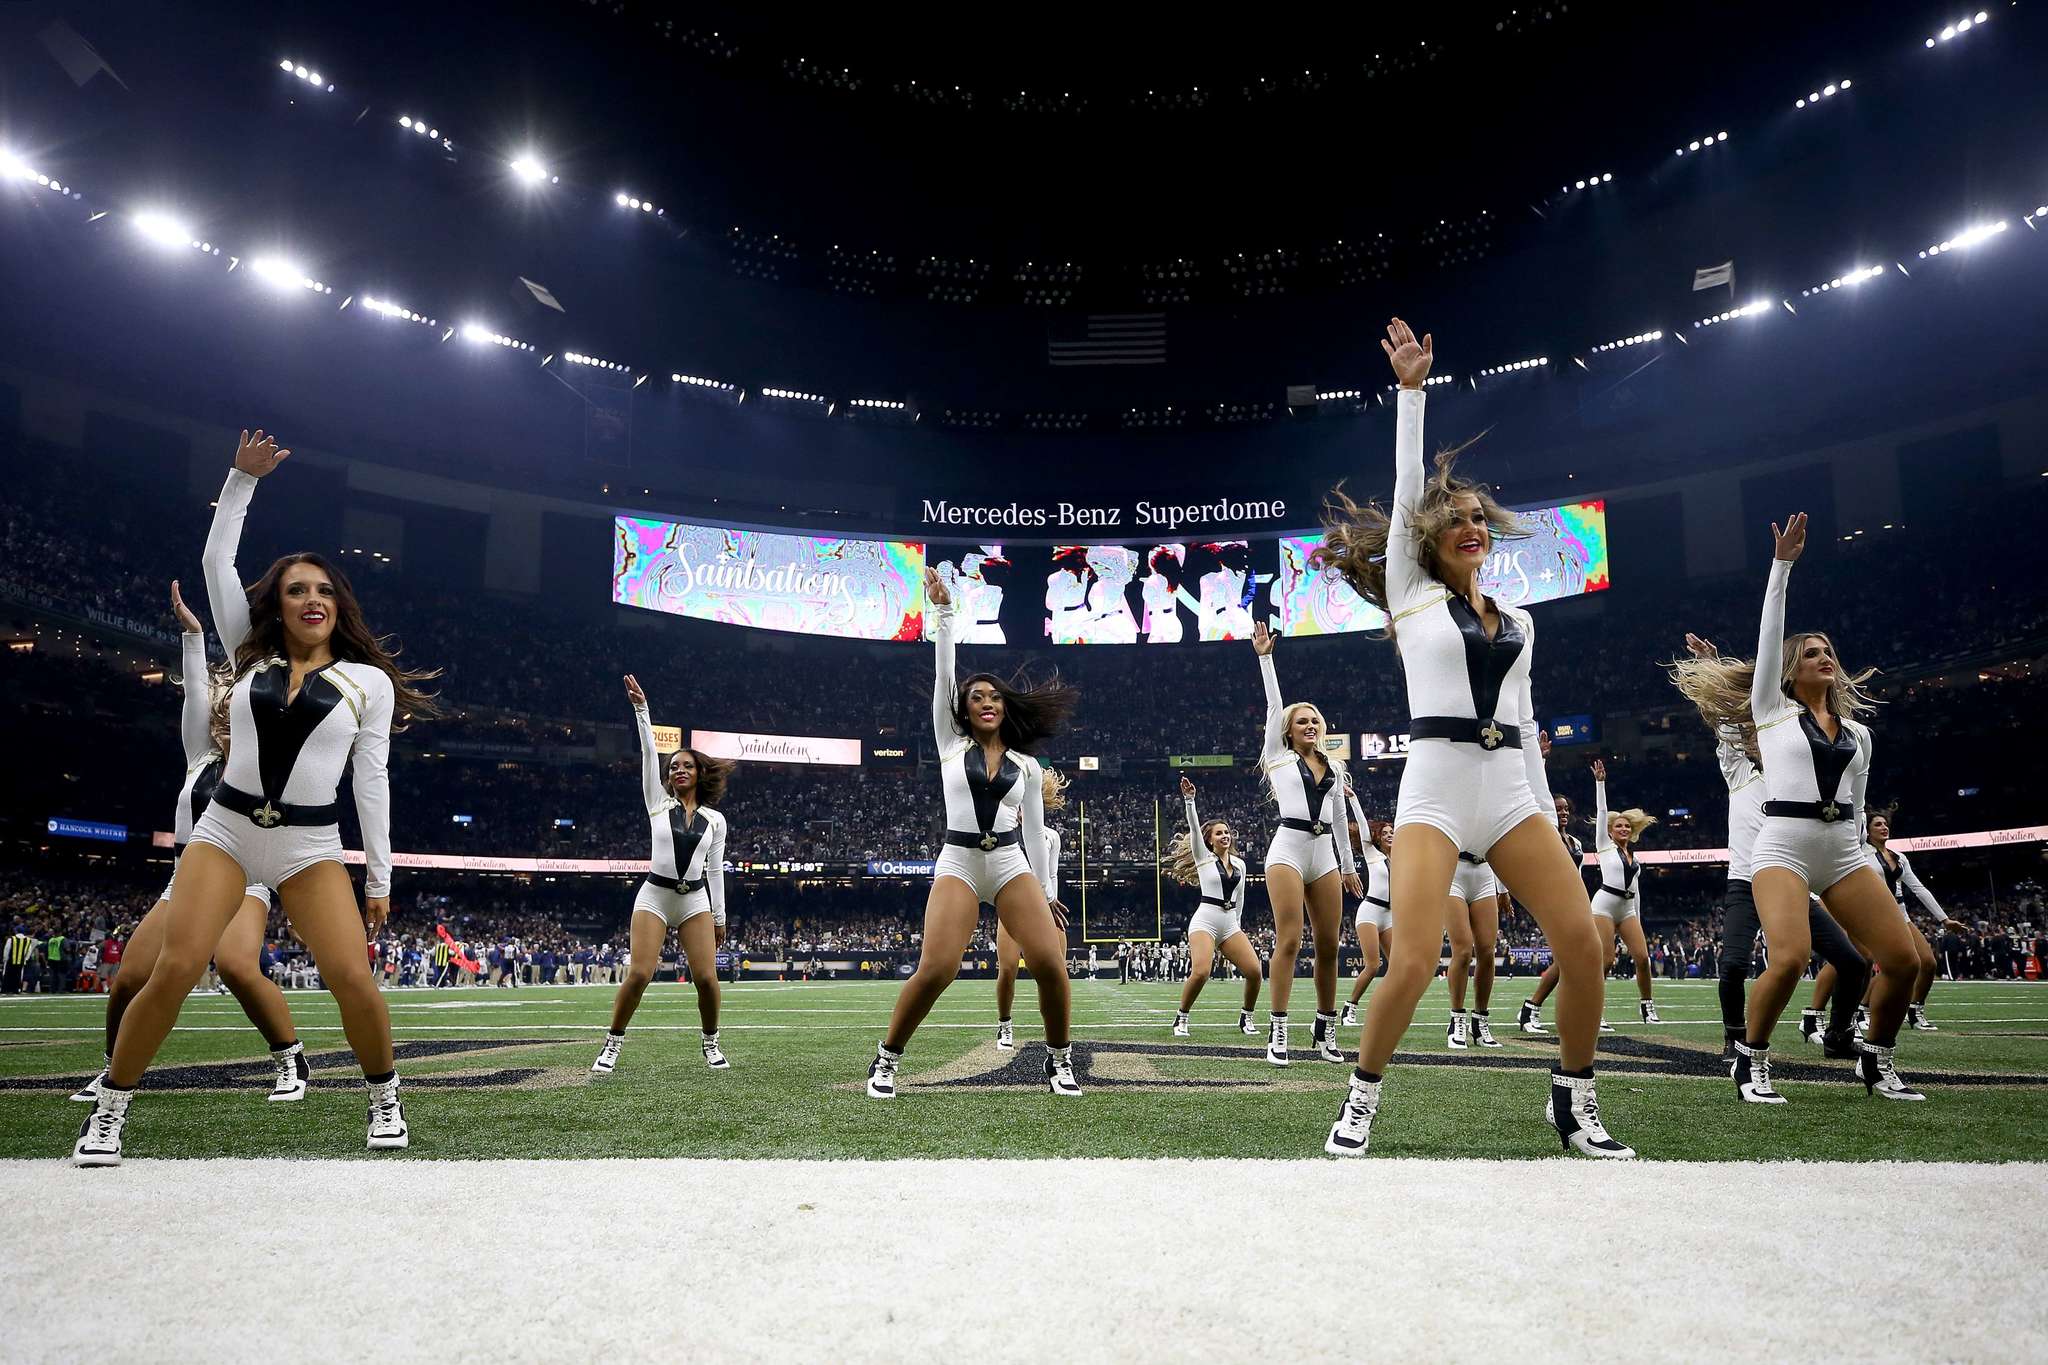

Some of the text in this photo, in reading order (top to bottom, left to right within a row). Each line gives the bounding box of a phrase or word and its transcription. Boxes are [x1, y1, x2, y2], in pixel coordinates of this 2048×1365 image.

[921, 498, 1286, 530] Mercedes-Benz Superdome
[661, 541, 857, 625] Saintsations
[652, 731, 678, 743] OUSES
[737, 734, 811, 764] Saintsations
[873, 748, 904, 757] verizon
[59, 823, 93, 834] HANCOCK
[881, 861, 933, 875] Ochsner
